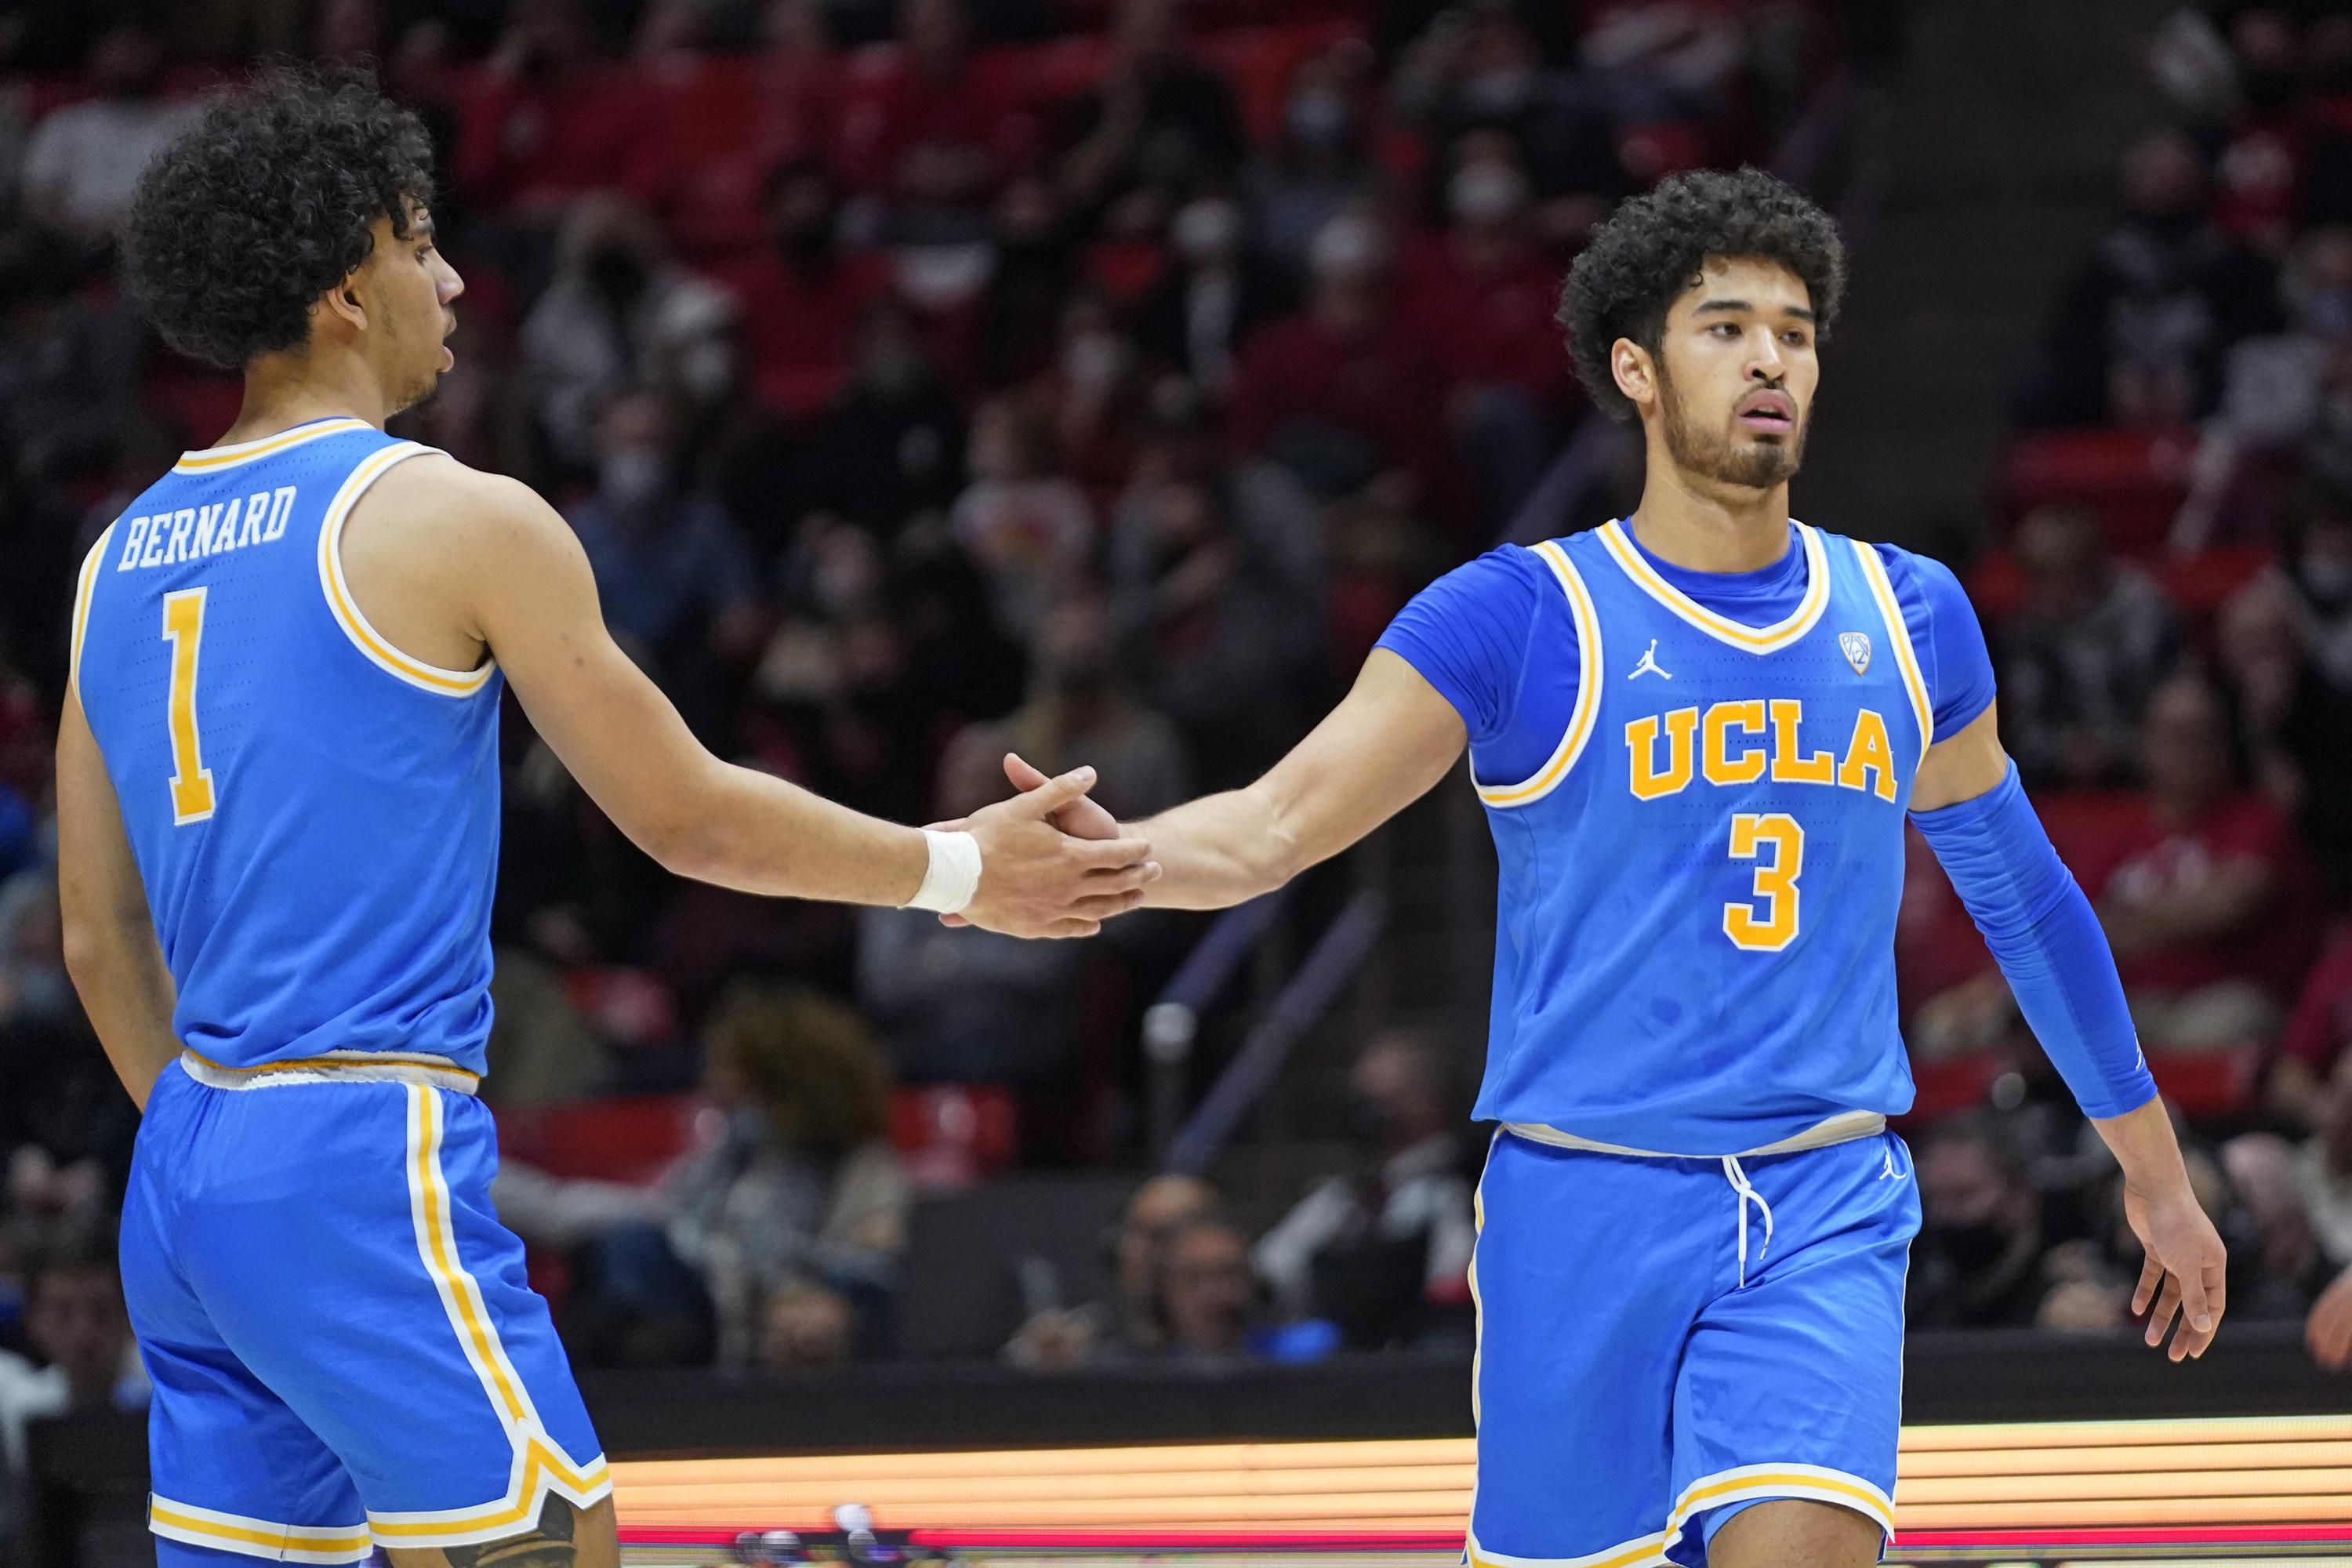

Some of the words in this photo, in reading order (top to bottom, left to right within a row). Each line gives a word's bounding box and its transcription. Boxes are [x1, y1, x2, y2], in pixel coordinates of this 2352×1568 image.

[117, 485, 297, 572] BERNARD
[162, 586, 216, 826] 1
[1851, 650, 1866, 664] 12
[1624, 699, 1897, 804] UCLA
[1722, 812, 1805, 952] 3
